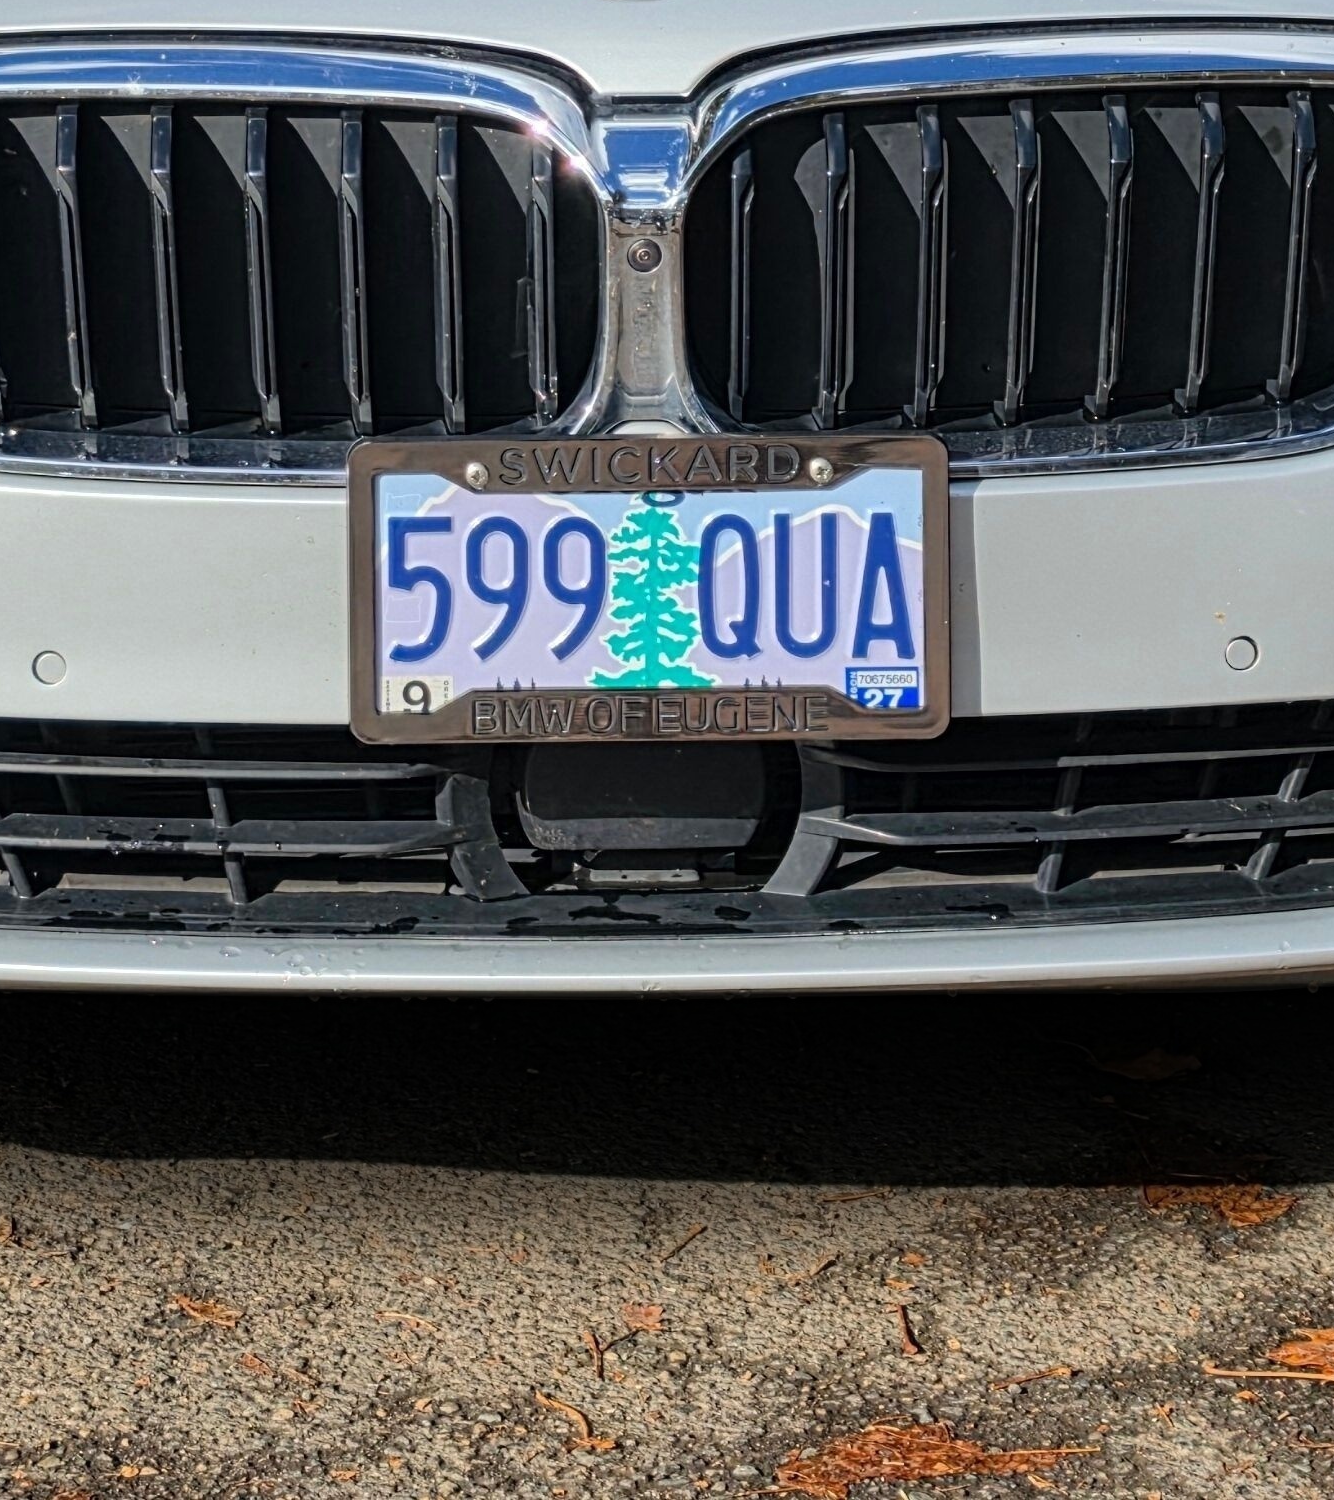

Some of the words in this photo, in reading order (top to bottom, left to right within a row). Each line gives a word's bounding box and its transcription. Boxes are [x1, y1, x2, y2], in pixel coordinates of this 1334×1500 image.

[499, 444, 801, 486] SWICKARD
[387, 515, 606, 662] 599
[697, 511, 915, 659] QUA
[403, 680, 432, 714] 9
[472, 698, 575, 735] BMW
[586, 697, 650, 733] OF
[652, 695, 829, 732] EUGENE
[864, 688, 904, 708] 27
